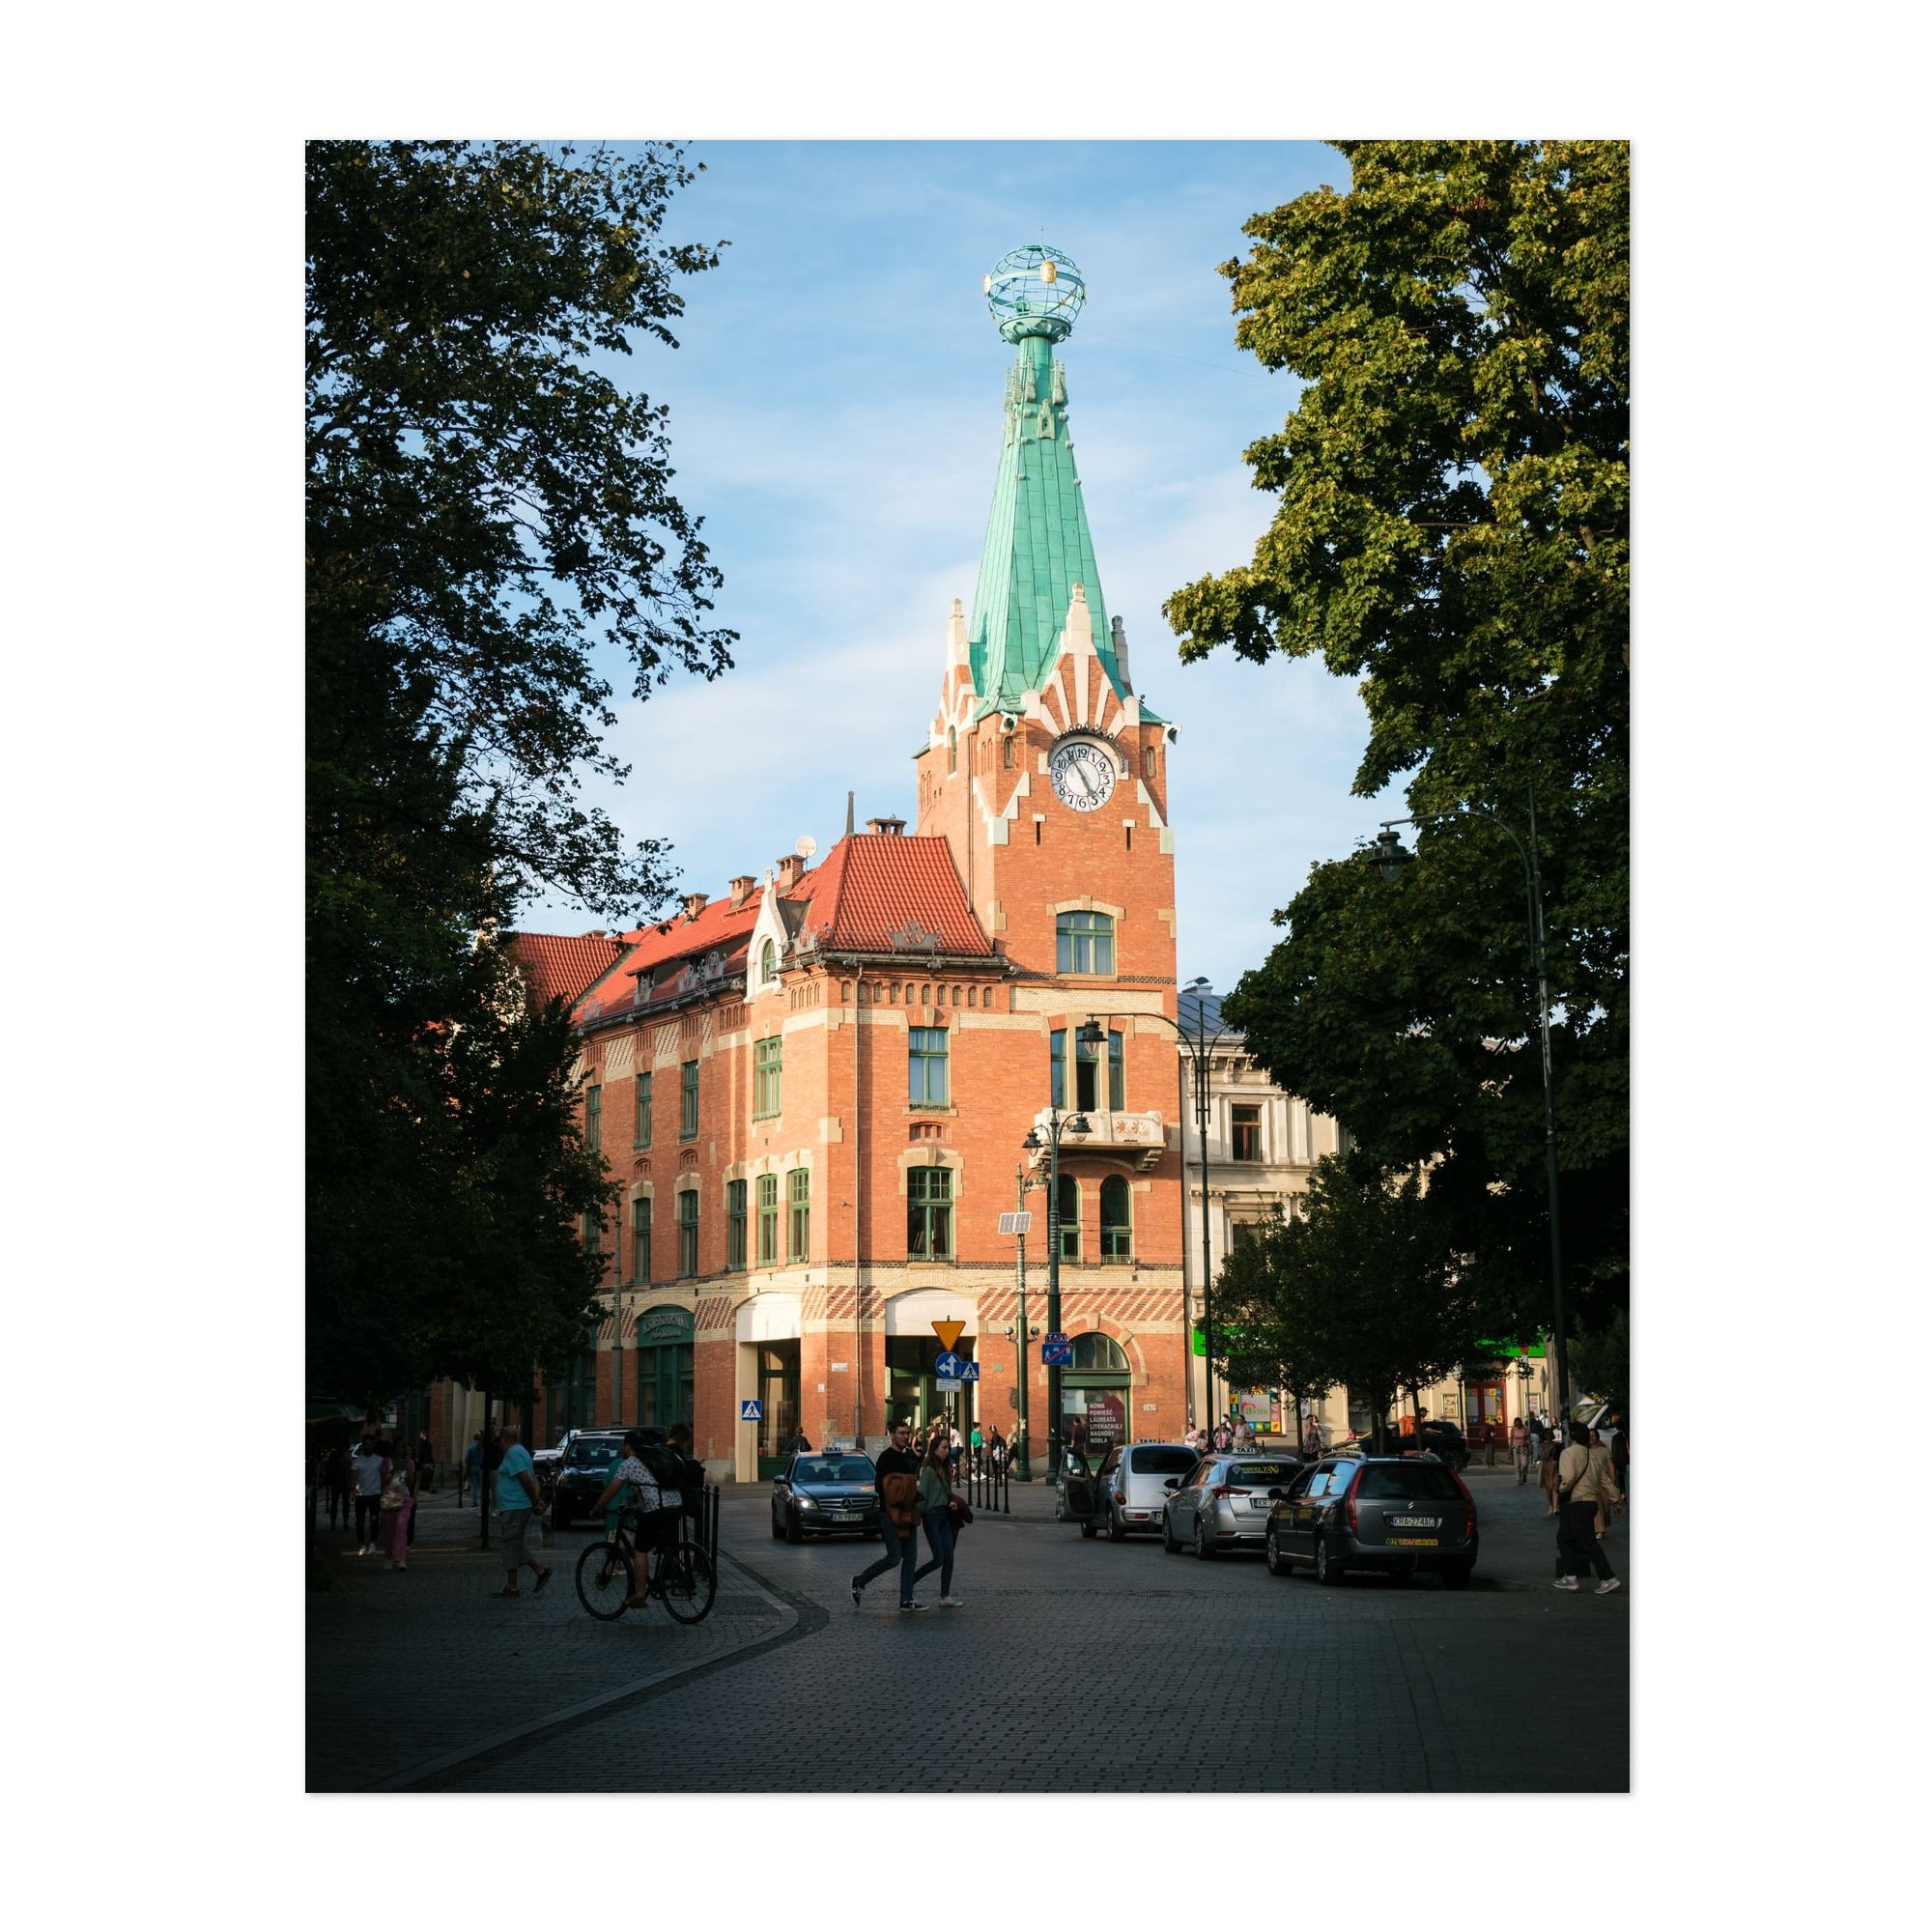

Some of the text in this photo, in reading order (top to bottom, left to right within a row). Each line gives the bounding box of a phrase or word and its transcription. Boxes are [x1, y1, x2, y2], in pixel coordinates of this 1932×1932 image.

[1077, 748, 1088, 758] 12
[1057, 758, 1066, 769] 10
[1099, 762, 1107, 772] 2
[1055, 772, 1063, 781] 9
[1103, 775, 1110, 785] 3
[1059, 784, 1065, 796] 8
[1099, 787, 1106, 798] 4
[1068, 794, 1074, 805] 7
[1079, 798, 1087, 809] 6
[1091, 795, 1098, 806] 5
